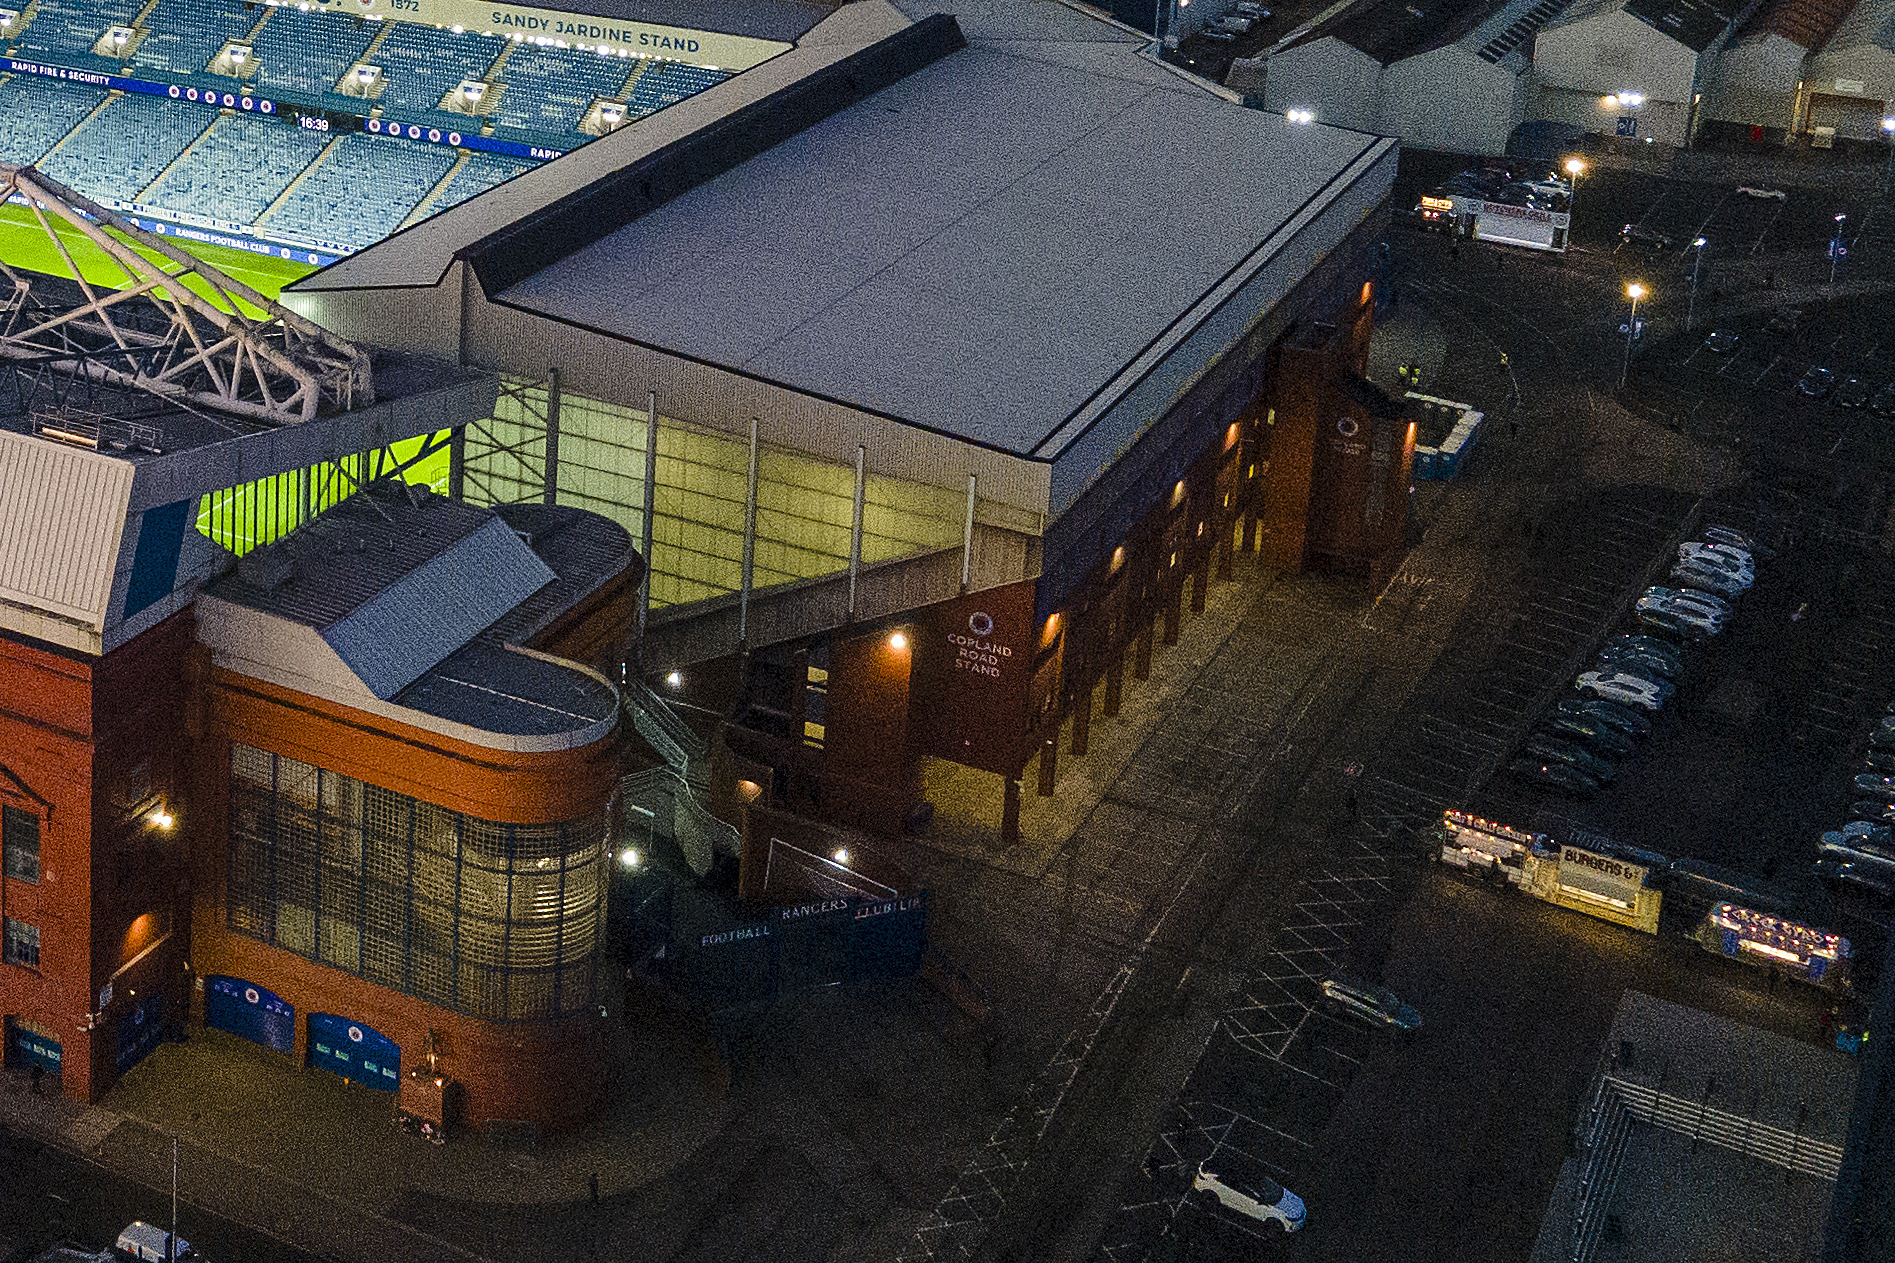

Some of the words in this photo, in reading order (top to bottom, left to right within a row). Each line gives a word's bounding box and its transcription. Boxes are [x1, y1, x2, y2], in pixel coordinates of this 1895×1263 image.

[491, 11, 550, 32] SANDY
[555, 20, 632, 43] JARDINE
[639, 33, 700, 53] STAND
[11, 61, 37, 73] RAPID
[39, 65, 58, 77] FIRE
[59, 69, 66, 78] &
[68, 70, 110, 85] SECURITY
[300, 116, 329, 131] 16:39
[175, 227, 209, 243] RANGERS
[210, 234, 249, 249] FOOTBALL
[249, 243, 270, 254] CLUB
[947, 633, 1012, 656] COPLAND
[955, 658, 1000, 677] STAND
[959, 648, 998, 665] ROAD
[1564, 849, 1623, 876] BURGERS
[702, 925, 770, 946] FOOTBALL
